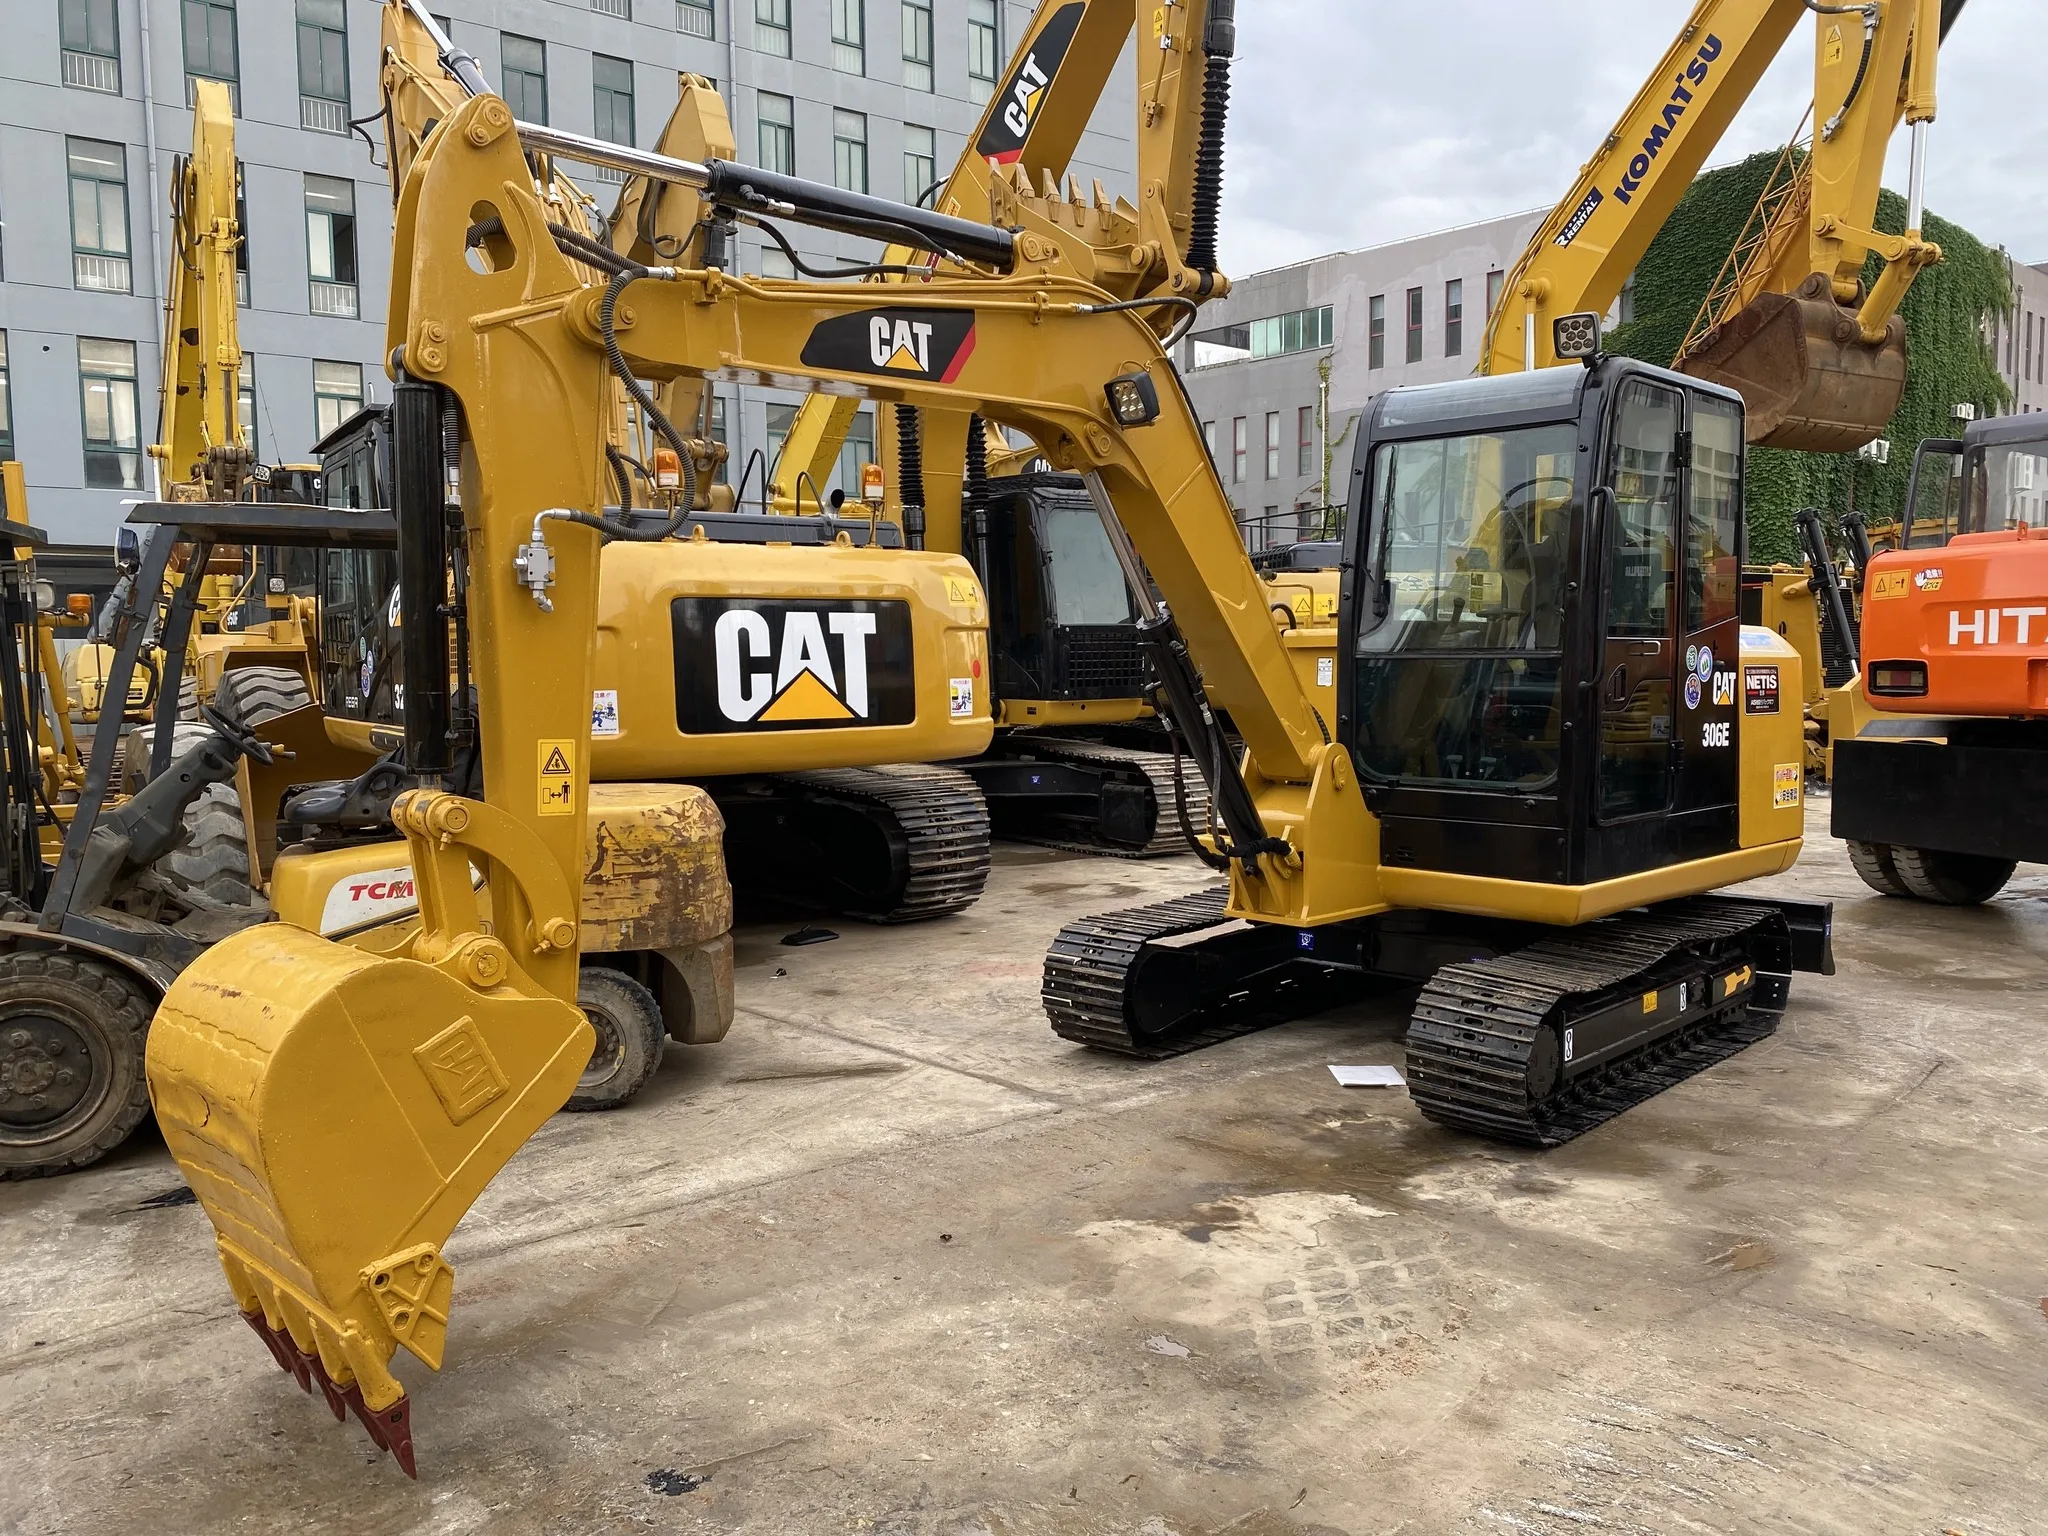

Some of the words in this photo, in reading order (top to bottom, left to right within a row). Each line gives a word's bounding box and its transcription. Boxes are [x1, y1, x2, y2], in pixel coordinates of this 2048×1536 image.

[1004, 52, 1049, 138] CAT
[1613, 33, 1722, 206] KOMATSU
[1566, 200, 1599, 241] RENTAL
[869, 316, 932, 373] CAT
[1948, 606, 2048, 645] HIT
[714, 609, 877, 722] CAT
[1746, 674, 1778, 690] NETIS
[1713, 671, 1737, 705] CAT
[1702, 722, 1730, 747] 306E
[348, 881, 414, 902] TCM
[430, 1030, 501, 1111] CAT
